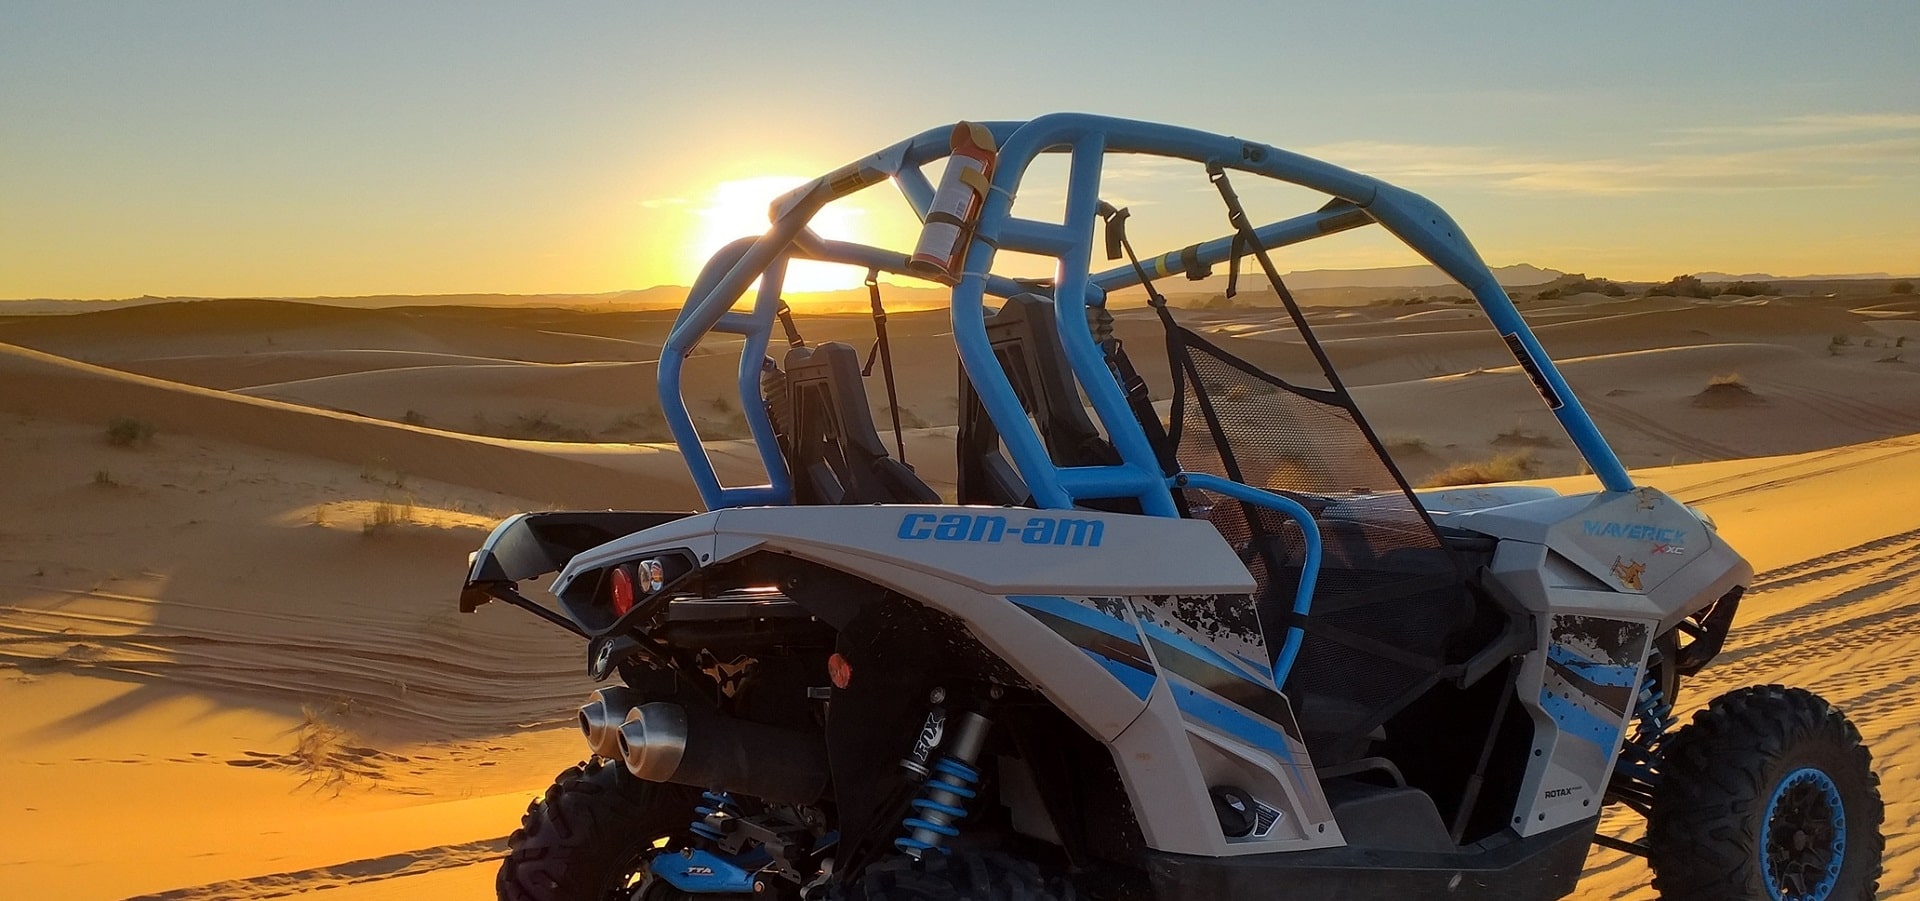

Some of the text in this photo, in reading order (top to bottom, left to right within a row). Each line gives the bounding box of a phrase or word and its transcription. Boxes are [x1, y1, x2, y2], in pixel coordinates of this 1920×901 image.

[897, 513, 1105, 547] can-am
[1583, 520, 1687, 543] MAVERICK
[913, 712, 944, 762] FOX
[1544, 787, 1572, 799] ROTAX
